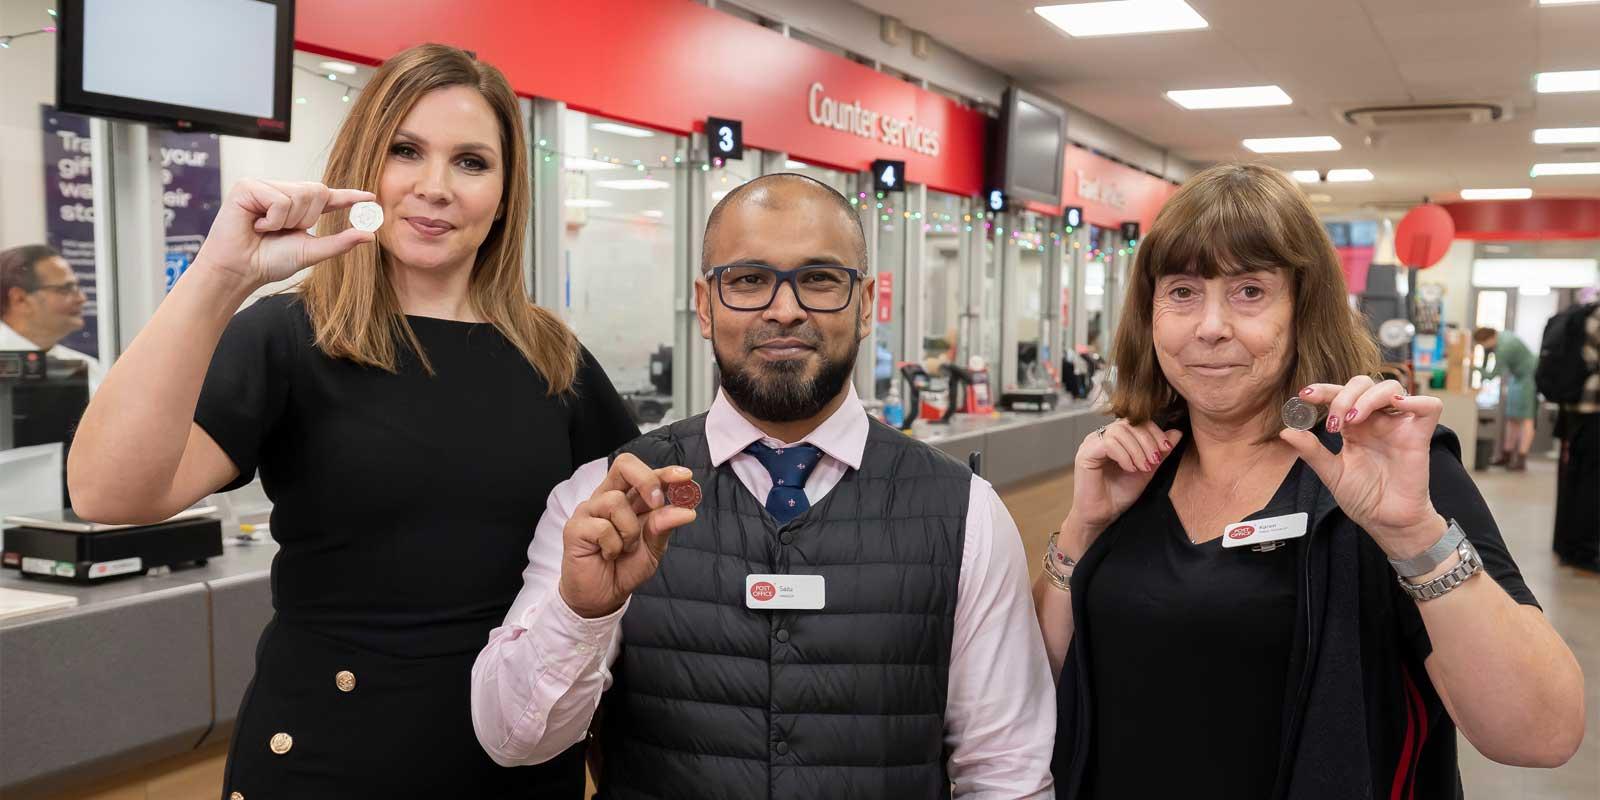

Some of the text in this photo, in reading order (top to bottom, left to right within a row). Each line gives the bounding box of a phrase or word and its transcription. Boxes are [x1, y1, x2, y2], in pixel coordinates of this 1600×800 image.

[809, 82, 940, 157] Counter services
[718, 126, 734, 152] 3
[160, 147, 208, 167] your
[881, 165, 896, 187] 4
[990, 190, 1003, 210] 5
